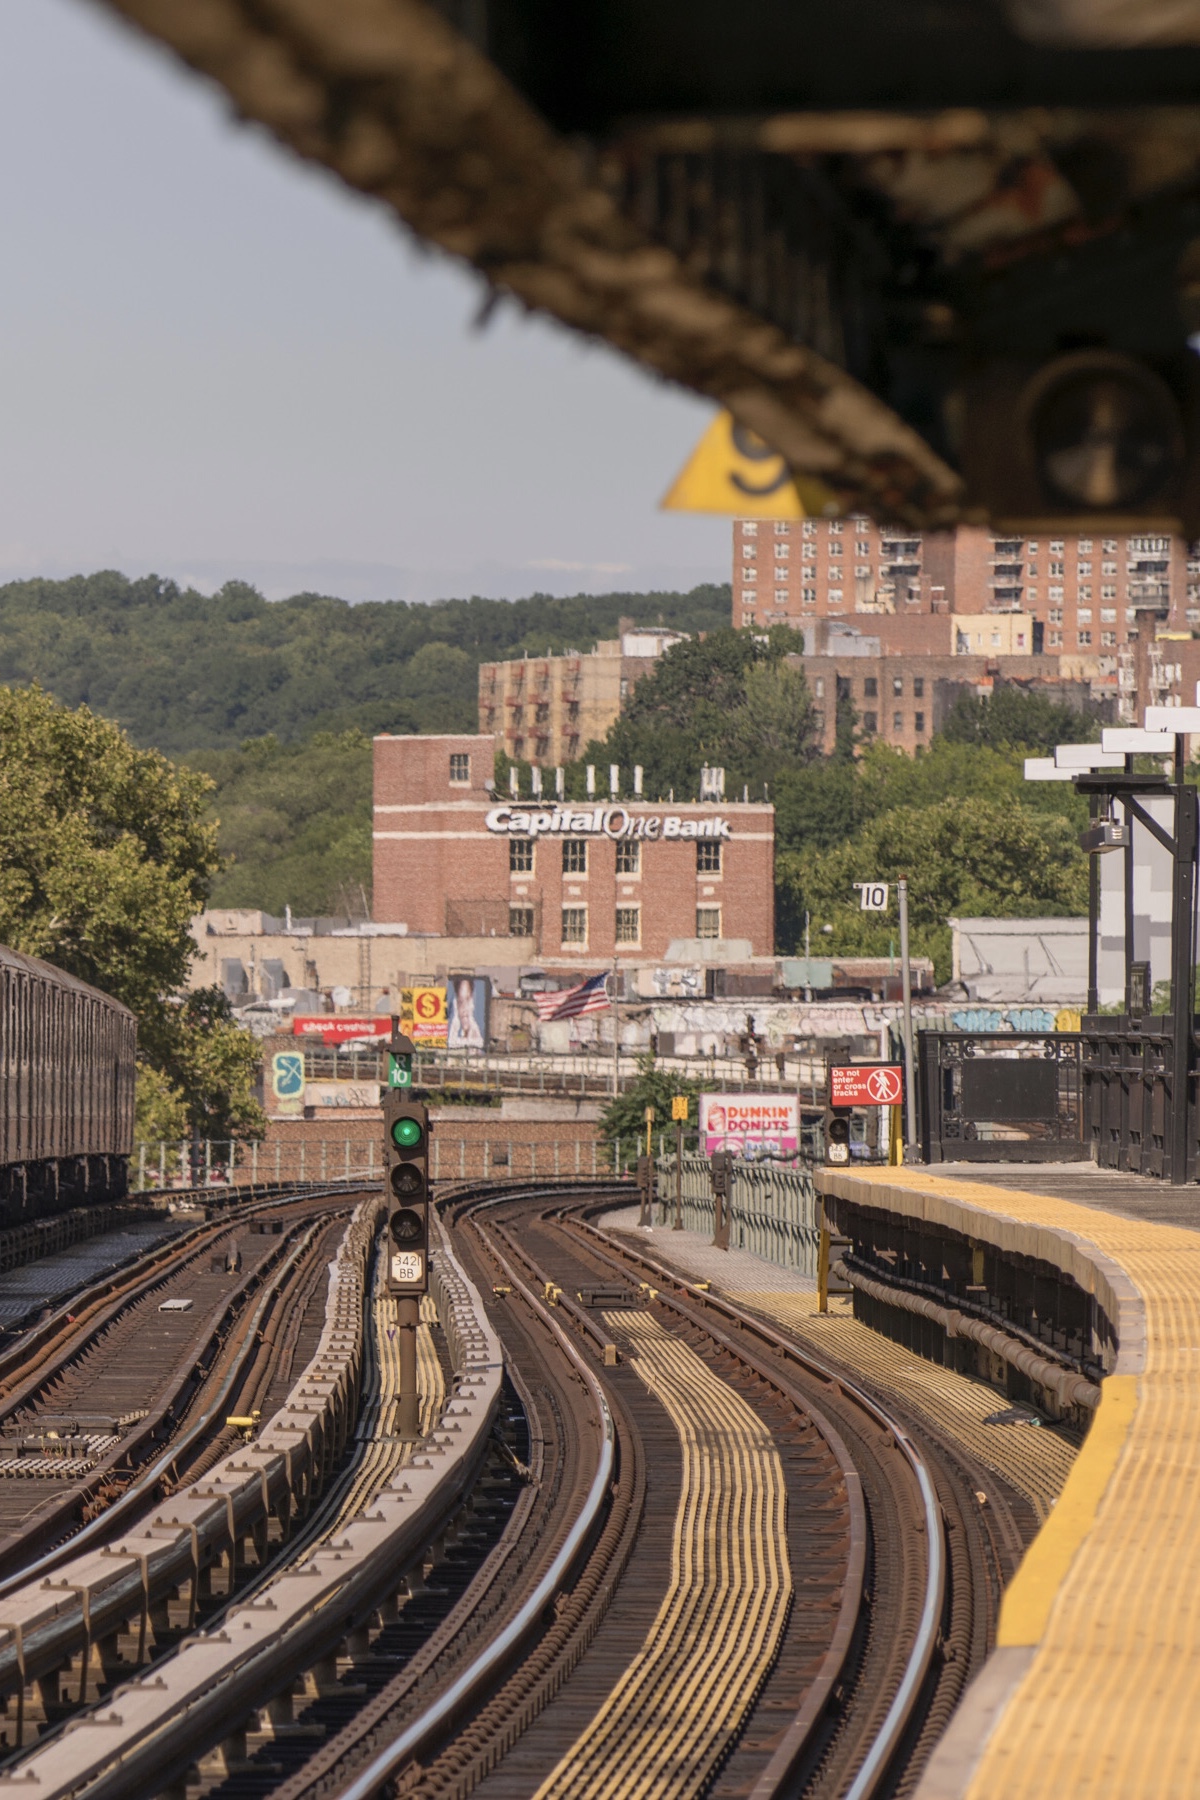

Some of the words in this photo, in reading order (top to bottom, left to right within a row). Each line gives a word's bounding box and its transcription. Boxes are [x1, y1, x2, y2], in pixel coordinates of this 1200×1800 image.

[485, 807, 603, 836] Capital
[603, 807, 661, 839] One
[662, 816, 730, 838] Bank
[866, 887, 884, 906] 10
[396, 1054, 406, 1068] R
[391, 1069, 408, 1084] 10
[832, 1069, 844, 1077] Do
[846, 1069, 860, 1077] not
[728, 1106, 792, 1118] DUNKIN'
[728, 1120, 789, 1132] DONUTS
[394, 1255, 420, 1266] 3421
[399, 1268, 414, 1279] BB
